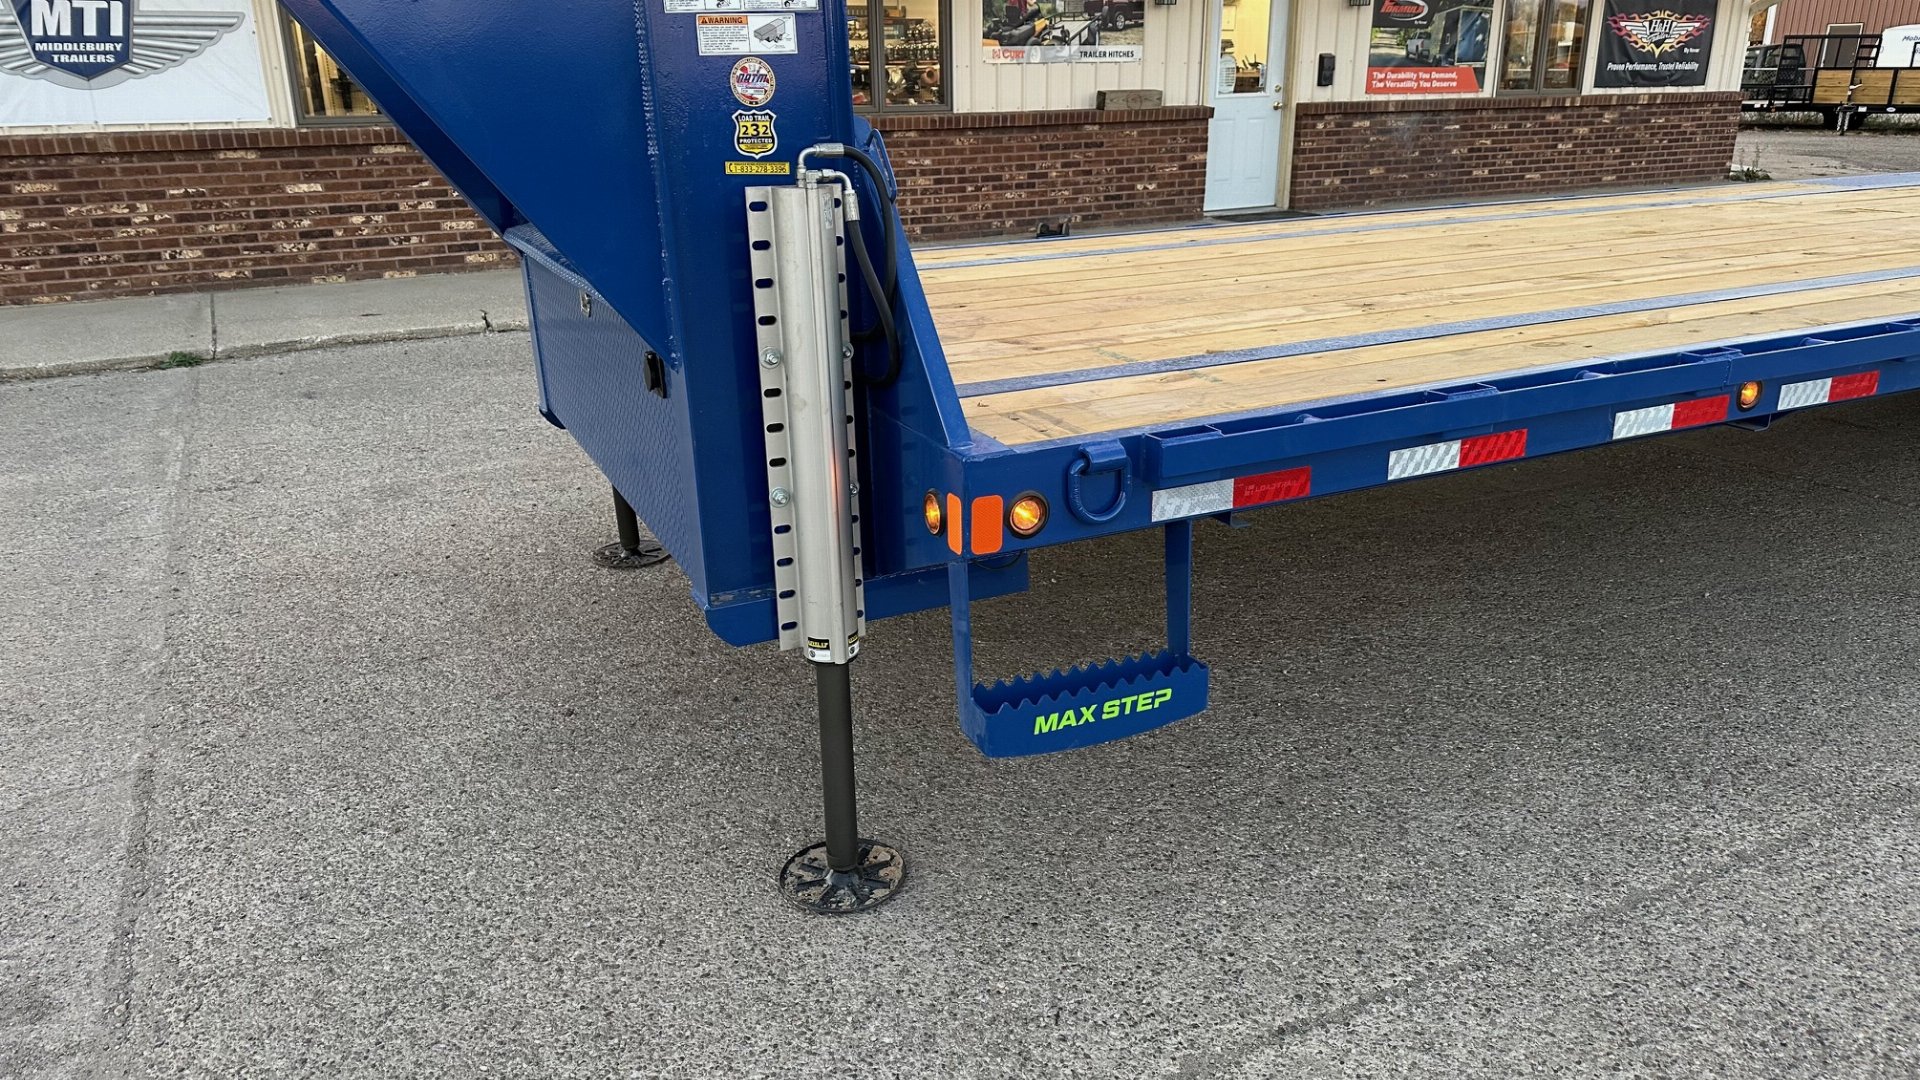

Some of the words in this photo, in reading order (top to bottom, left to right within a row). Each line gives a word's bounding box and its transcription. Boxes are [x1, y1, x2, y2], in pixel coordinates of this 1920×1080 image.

[31, 0, 123, 36] MTI
[35, 42, 123, 51] MIDDLEBURY
[51, 54, 116, 63] TRAILERS
[1080, 50, 1107, 58] TRAILER
[1108, 50, 1135, 58] HITCHES
[1607, 62, 1625, 71] Proven
[1625, 62, 1657, 71] Performance,
[1675, 61, 1699, 71] Reliability
[1372, 71, 1385, 79] The
[1386, 71, 1417, 80] Durability
[1418, 71, 1431, 79] You
[1431, 71, 1458, 80] Demand,
[1371, 80, 1385, 88] The
[1385, 80, 1418, 89] Versatility
[741, 123, 769, 136] 232
[1033, 704, 1098, 735] MAX
[1101, 688, 1172, 720] STEP
